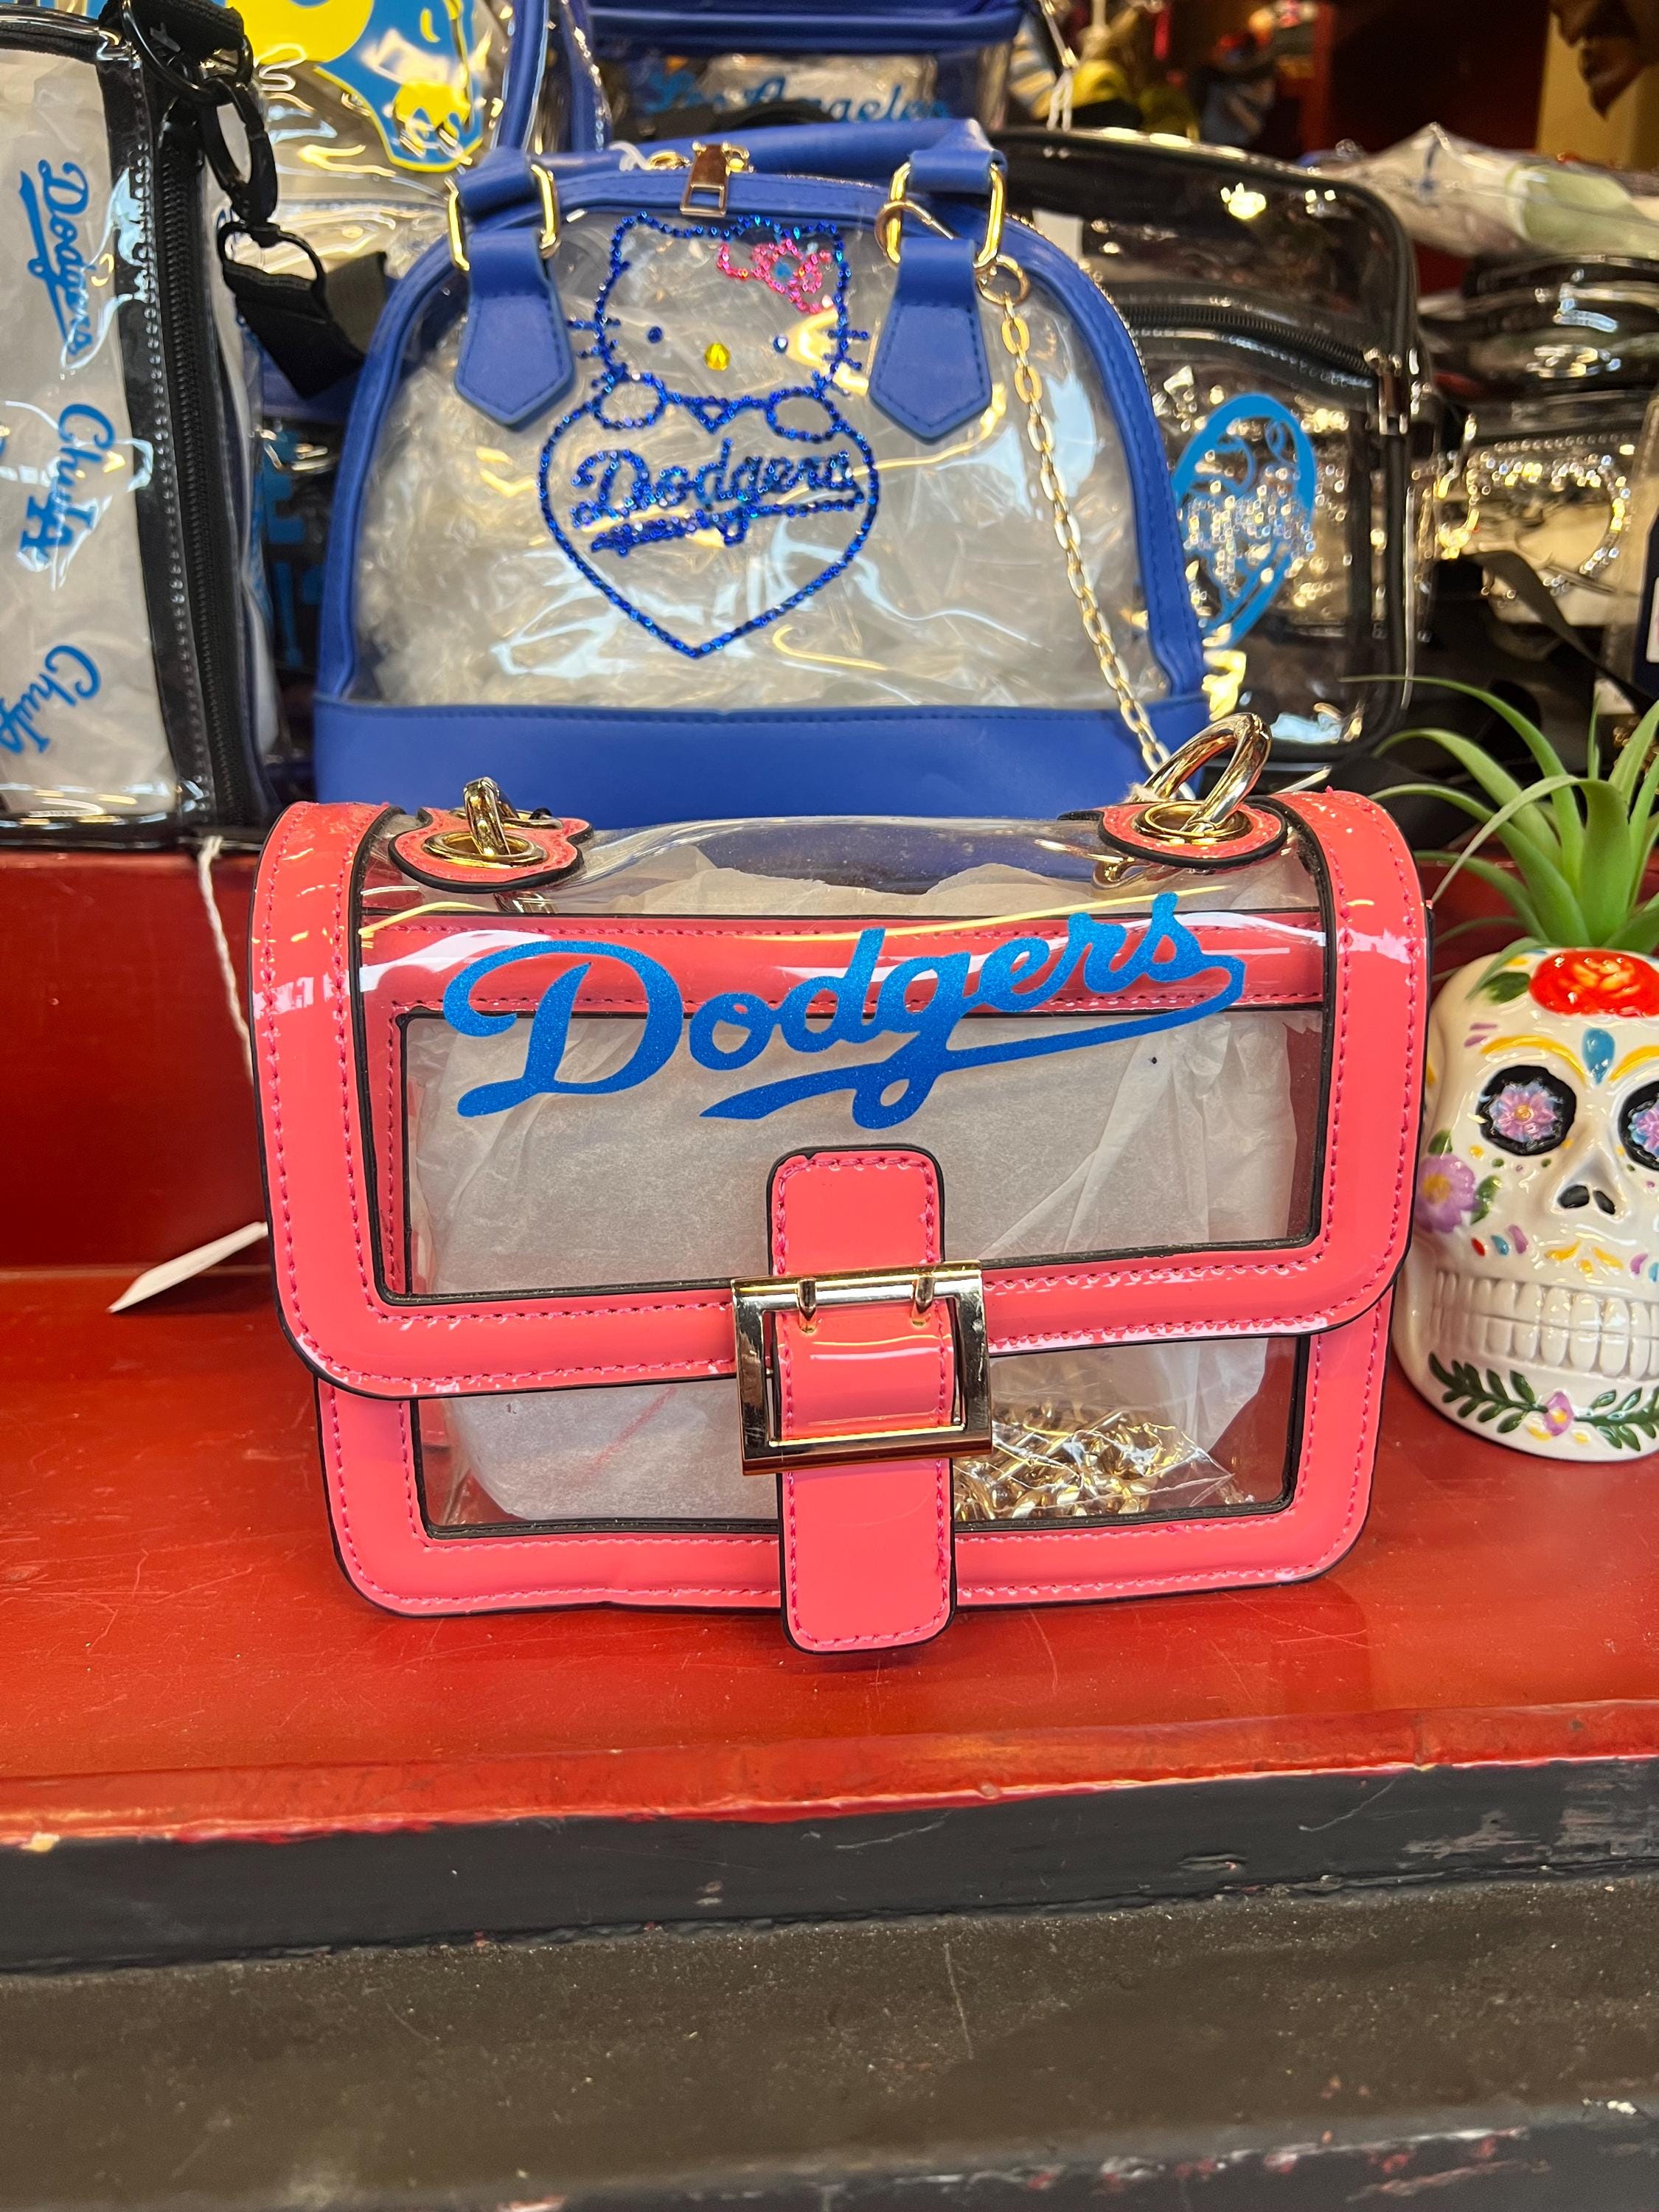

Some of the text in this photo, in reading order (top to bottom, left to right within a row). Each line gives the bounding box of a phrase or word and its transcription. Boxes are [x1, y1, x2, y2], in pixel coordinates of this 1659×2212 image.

[19, 159, 93, 355] Dodgers
[570, 438, 864, 557] Dodgers
[442, 892, 1246, 1130] Dodgers
